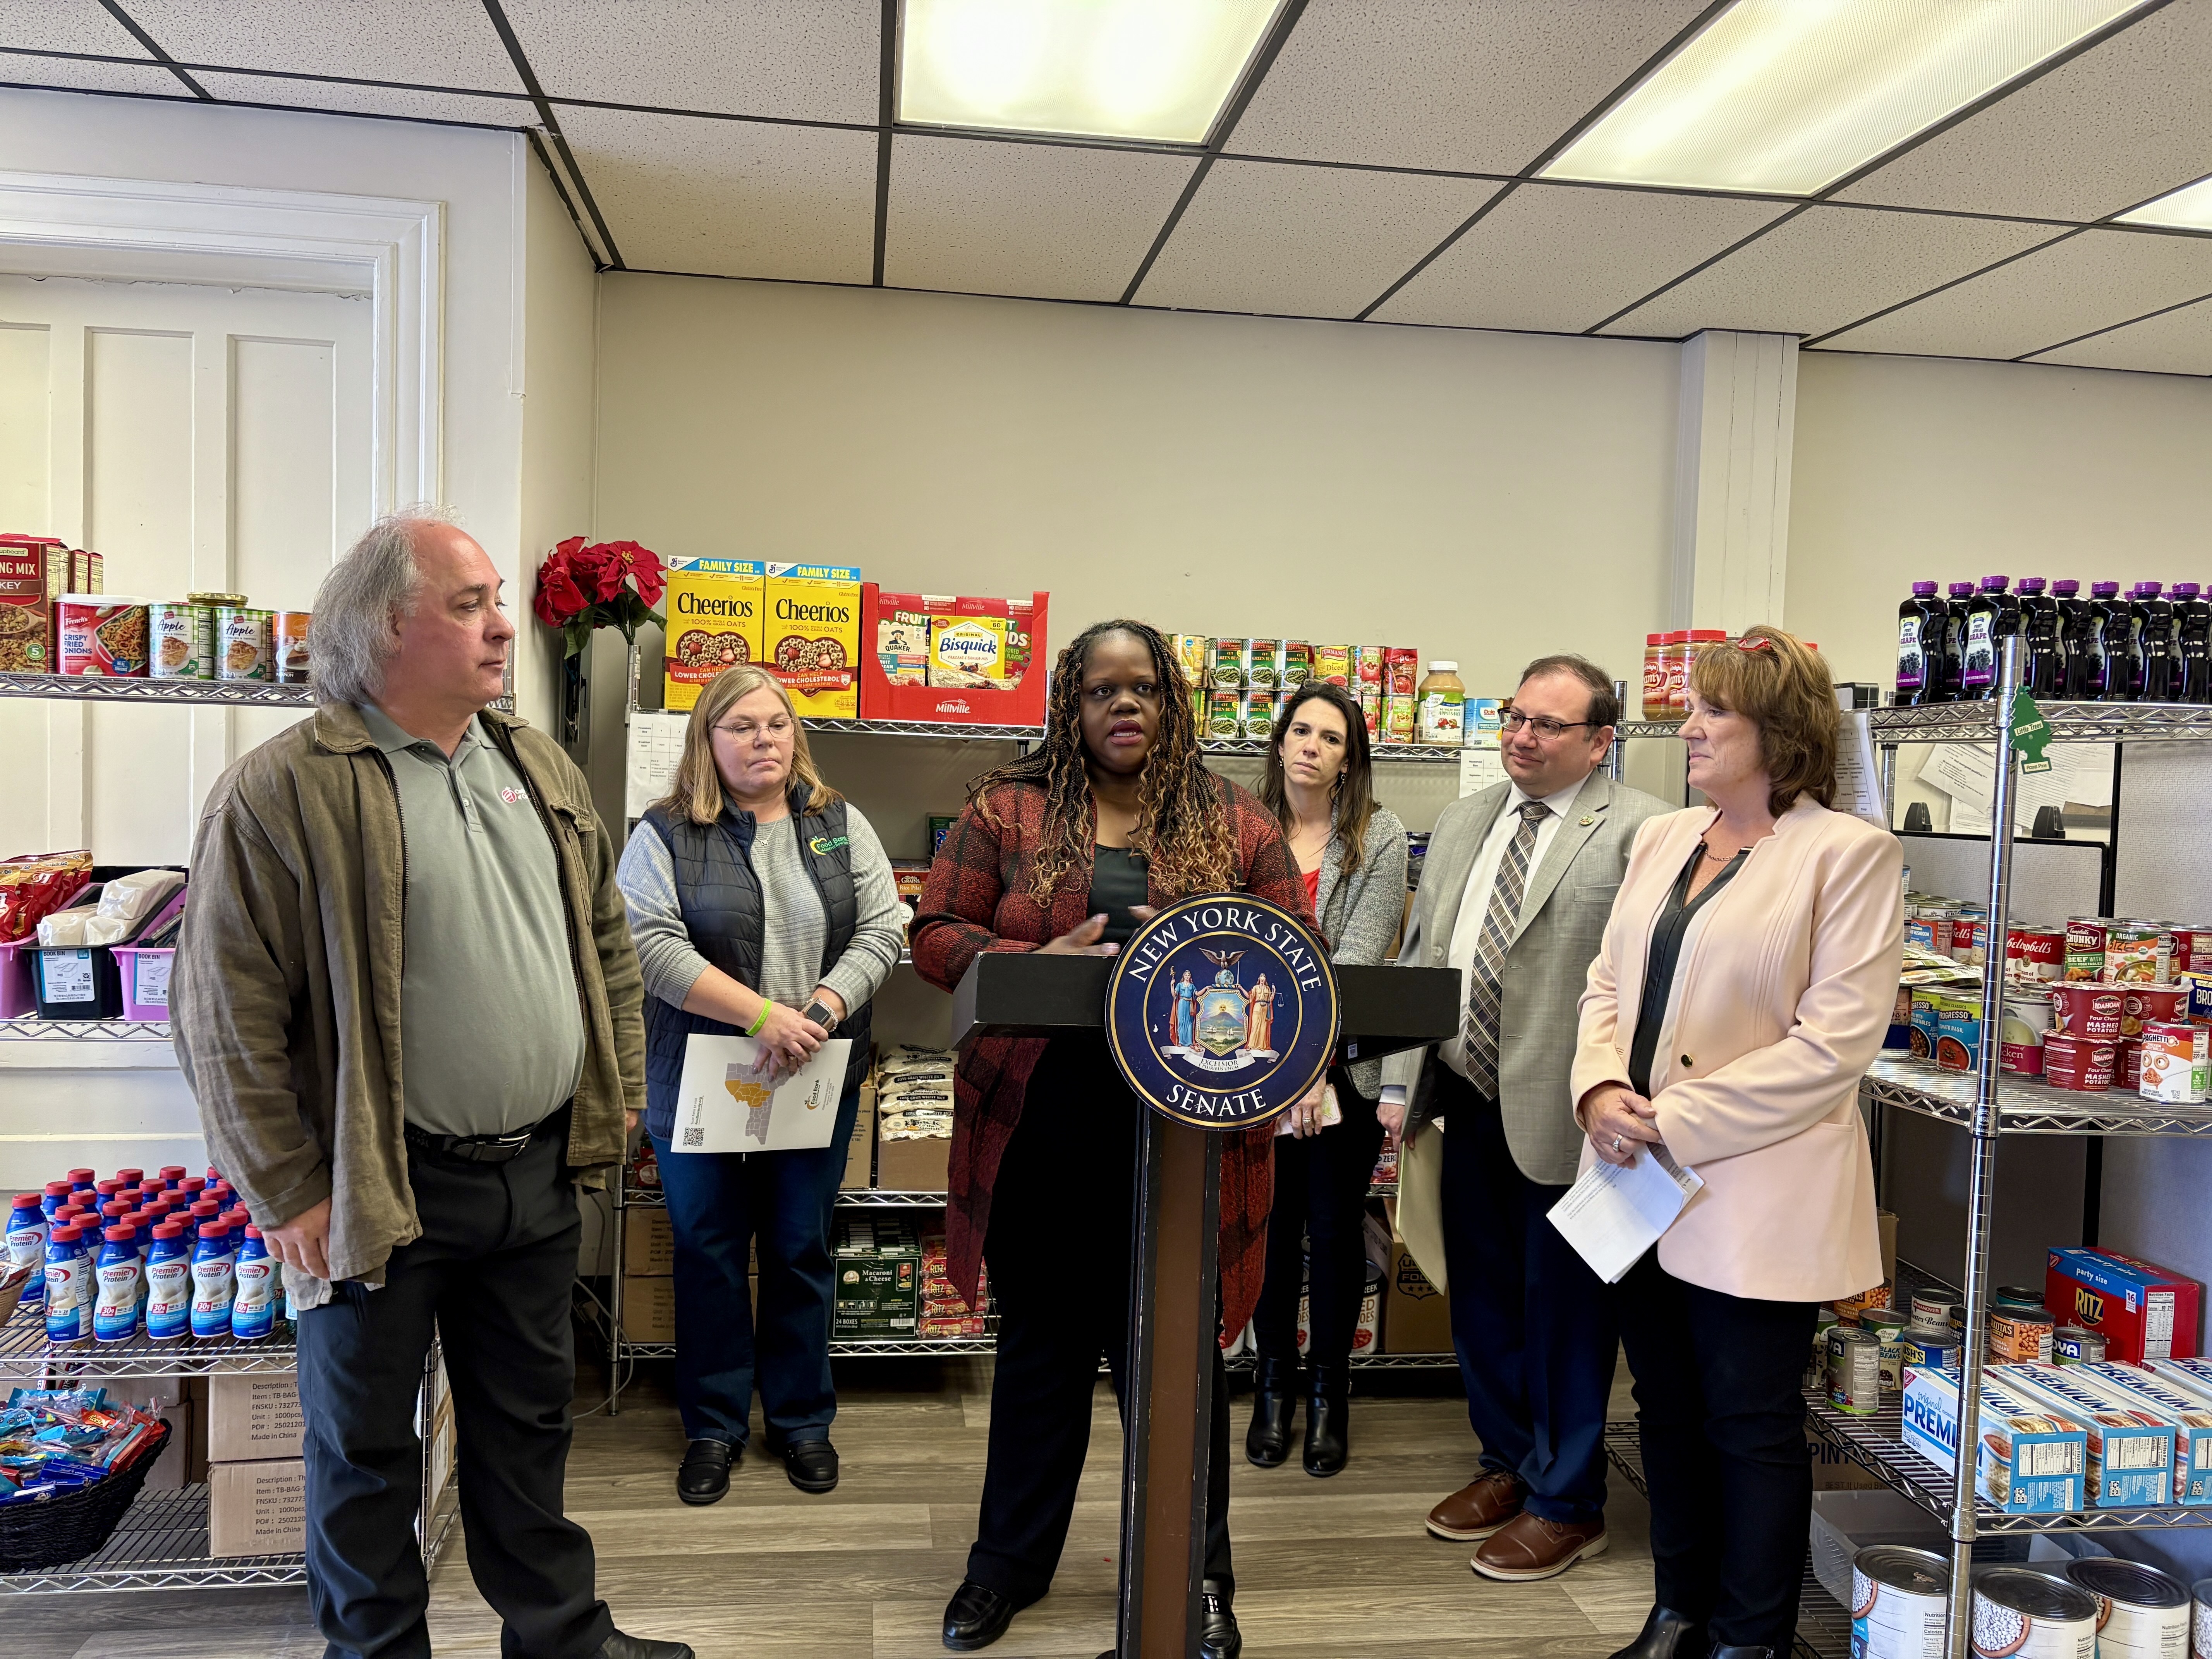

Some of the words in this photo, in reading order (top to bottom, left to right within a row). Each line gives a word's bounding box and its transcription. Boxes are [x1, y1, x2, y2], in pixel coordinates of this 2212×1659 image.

[16, 563, 36, 575] MIX
[699, 560, 732, 571] FAMILY
[734, 562, 753, 573] SIZE
[797, 566, 830, 578] FAMILY
[831, 569, 850, 579] SIZE
[678, 592, 753, 617] Cheerios
[776, 598, 849, 623] Cheerios
[895, 611, 930, 625] FRUIT
[158, 619, 185, 632] Apple
[226, 623, 255, 636] Apple
[940, 638, 996, 654] Bisquick
[936, 702, 970, 713] Millville
[817, 840, 833, 849] Food
[2066, 933, 2098, 945] CHUNKY
[1129, 921, 1179, 983] NEW
[1182, 907, 1264, 934] YORK
[1265, 923, 1322, 992] STATE
[1201, 1058, 1238, 1067] EXCELSIOR
[1166, 1084, 1267, 1117] SENATE
[930, 1264, 945, 1274] RITZ
[2083, 1256, 2116, 1267] party
[2116, 1267, 2136, 1276] size
[2076, 1268, 2094, 1281] party
[2095, 1274, 2107, 1285] size
[931, 1285, 945, 1293] RITZ
[2127, 1292, 2135, 1302] 16
[931, 1305, 945, 1314] RITZ
[1917, 1305, 1939, 1313] HANOVER
[2075, 1287, 2104, 1321] RITZ
[1925, 1317, 1948, 1327] Beans
[928, 1325, 941, 1334] RITZ
[253, 1382, 289, 1390] Description
[2011, 1365, 2119, 1412] PREMIUM
[2087, 1362, 2204, 1411] PREMIUM
[1918, 1392, 1942, 1412] original
